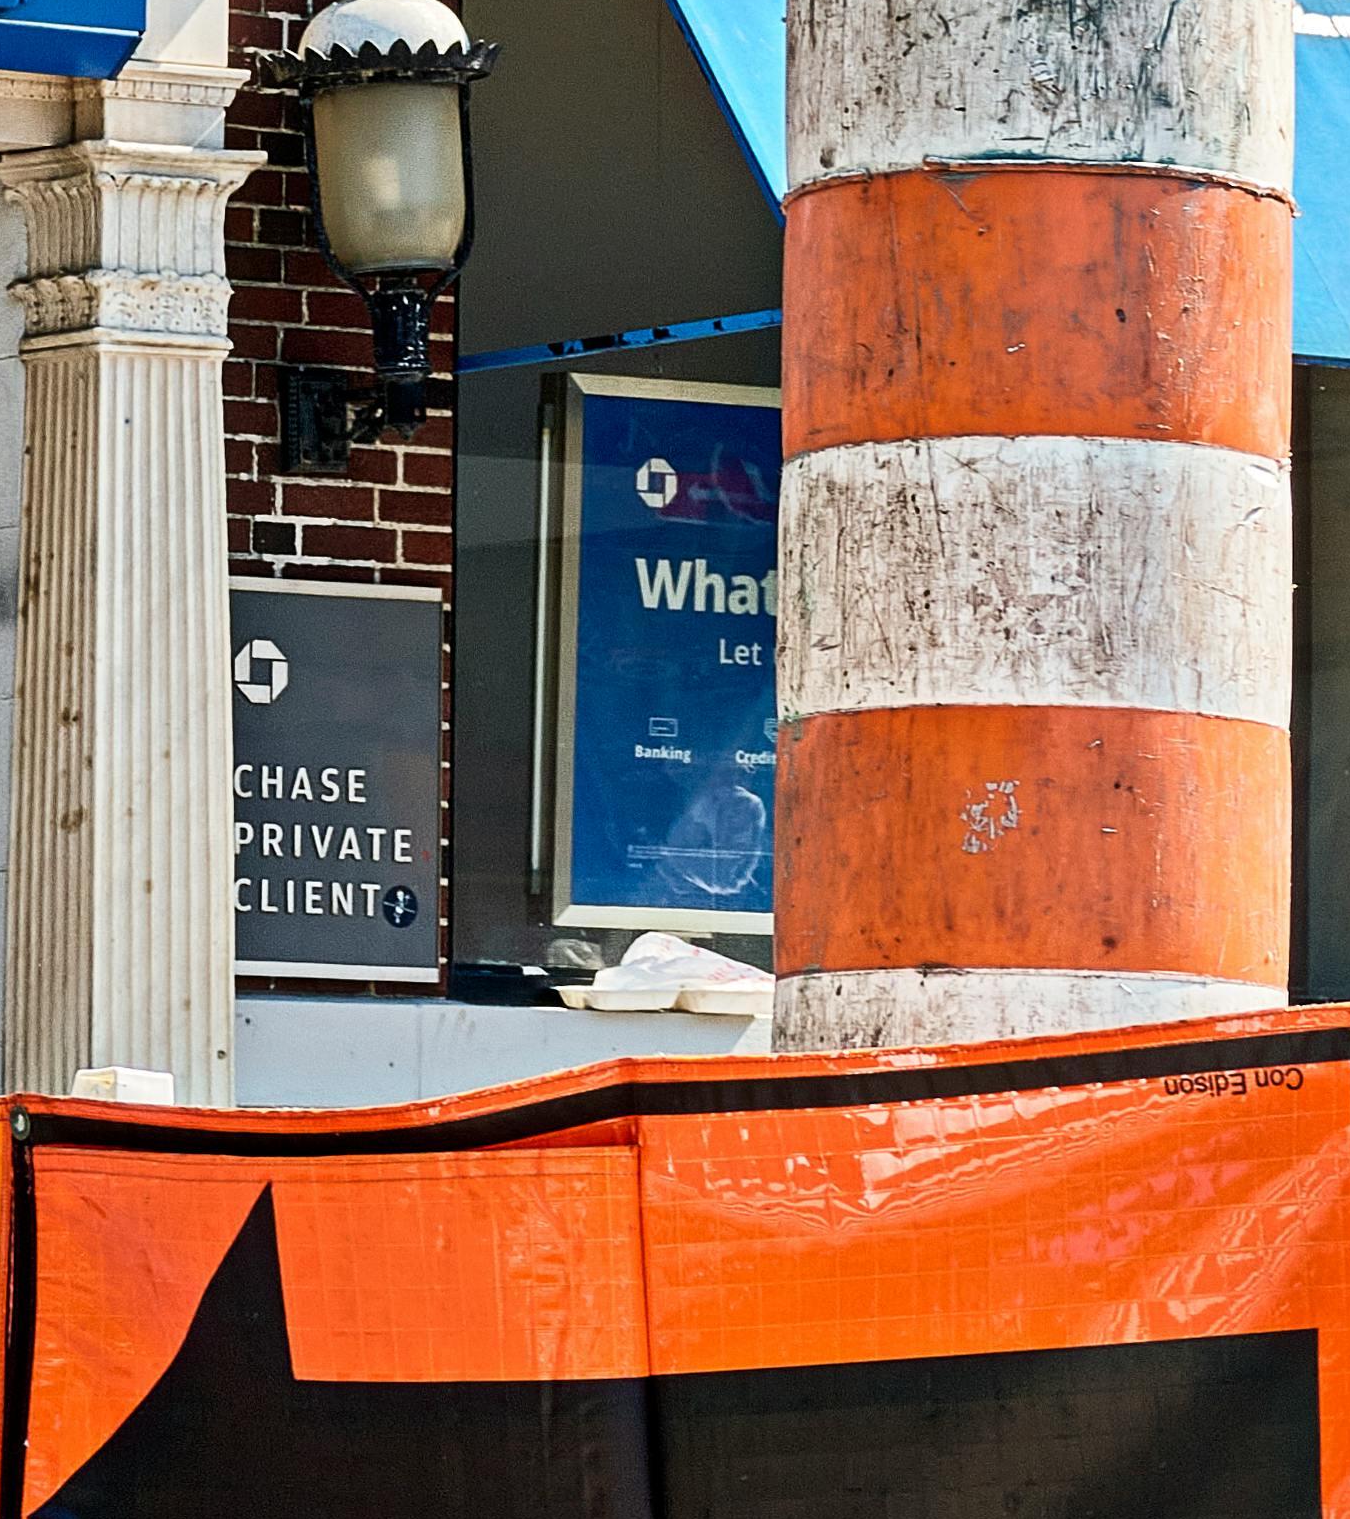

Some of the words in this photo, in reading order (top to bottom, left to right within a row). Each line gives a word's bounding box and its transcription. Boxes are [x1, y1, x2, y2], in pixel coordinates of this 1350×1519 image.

[634, 557, 779, 617] What
[719, 638, 762, 666] Let
[634, 744, 692, 764] Banking
[233, 764, 367, 804] CHASE
[234, 822, 414, 863] PRIVATE
[234, 877, 382, 917] CLIENT
[1164, 1072, 1247, 1097] Edison
[1254, 1067, 1304, 1091] Con
